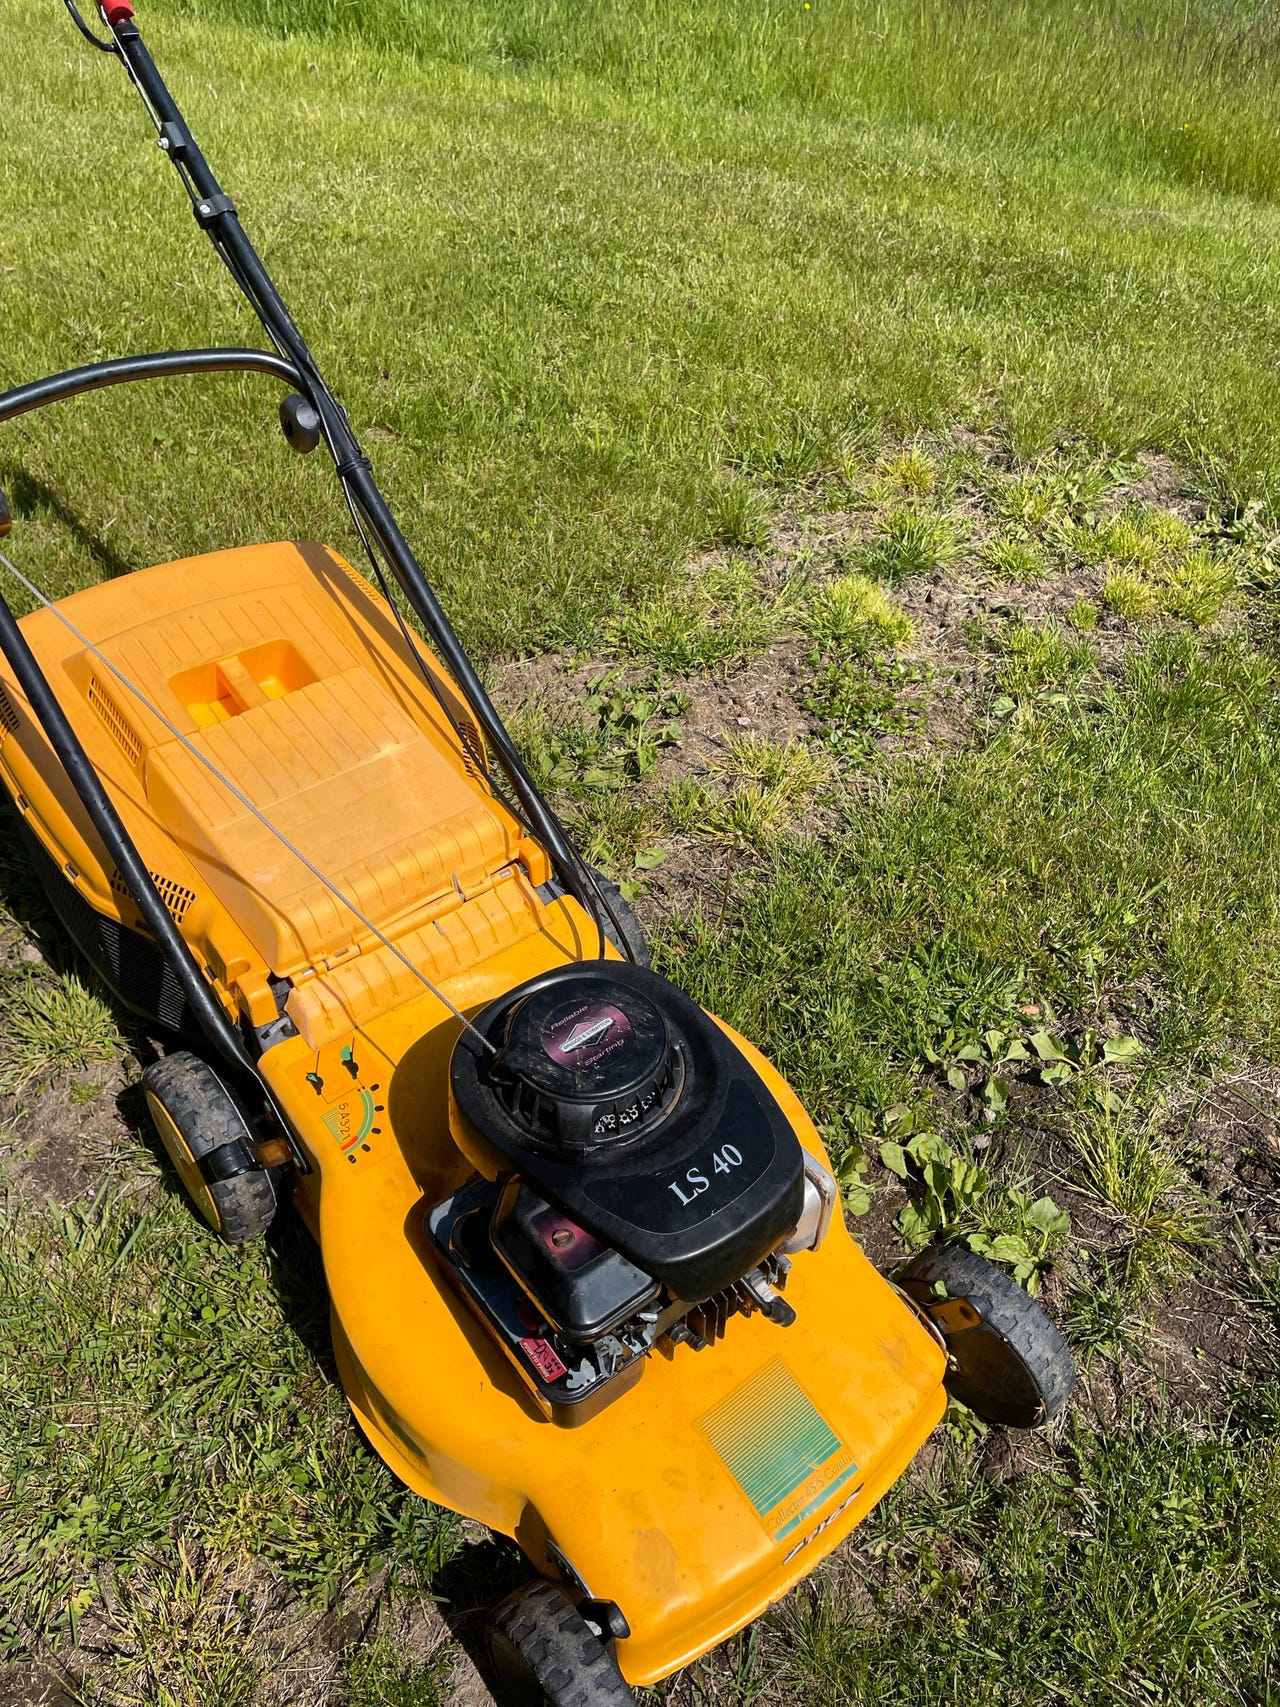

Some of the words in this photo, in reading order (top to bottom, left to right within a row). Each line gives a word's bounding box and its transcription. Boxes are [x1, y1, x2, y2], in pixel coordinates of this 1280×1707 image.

[551, 1005, 588, 1030] Reliable
[585, 1038, 624, 1066] Starting
[667, 1167, 710, 1206] LS
[713, 1144, 743, 1174] 40
[767, 1497, 804, 1530] Collector
[824, 1454, 852, 1481] Combi
